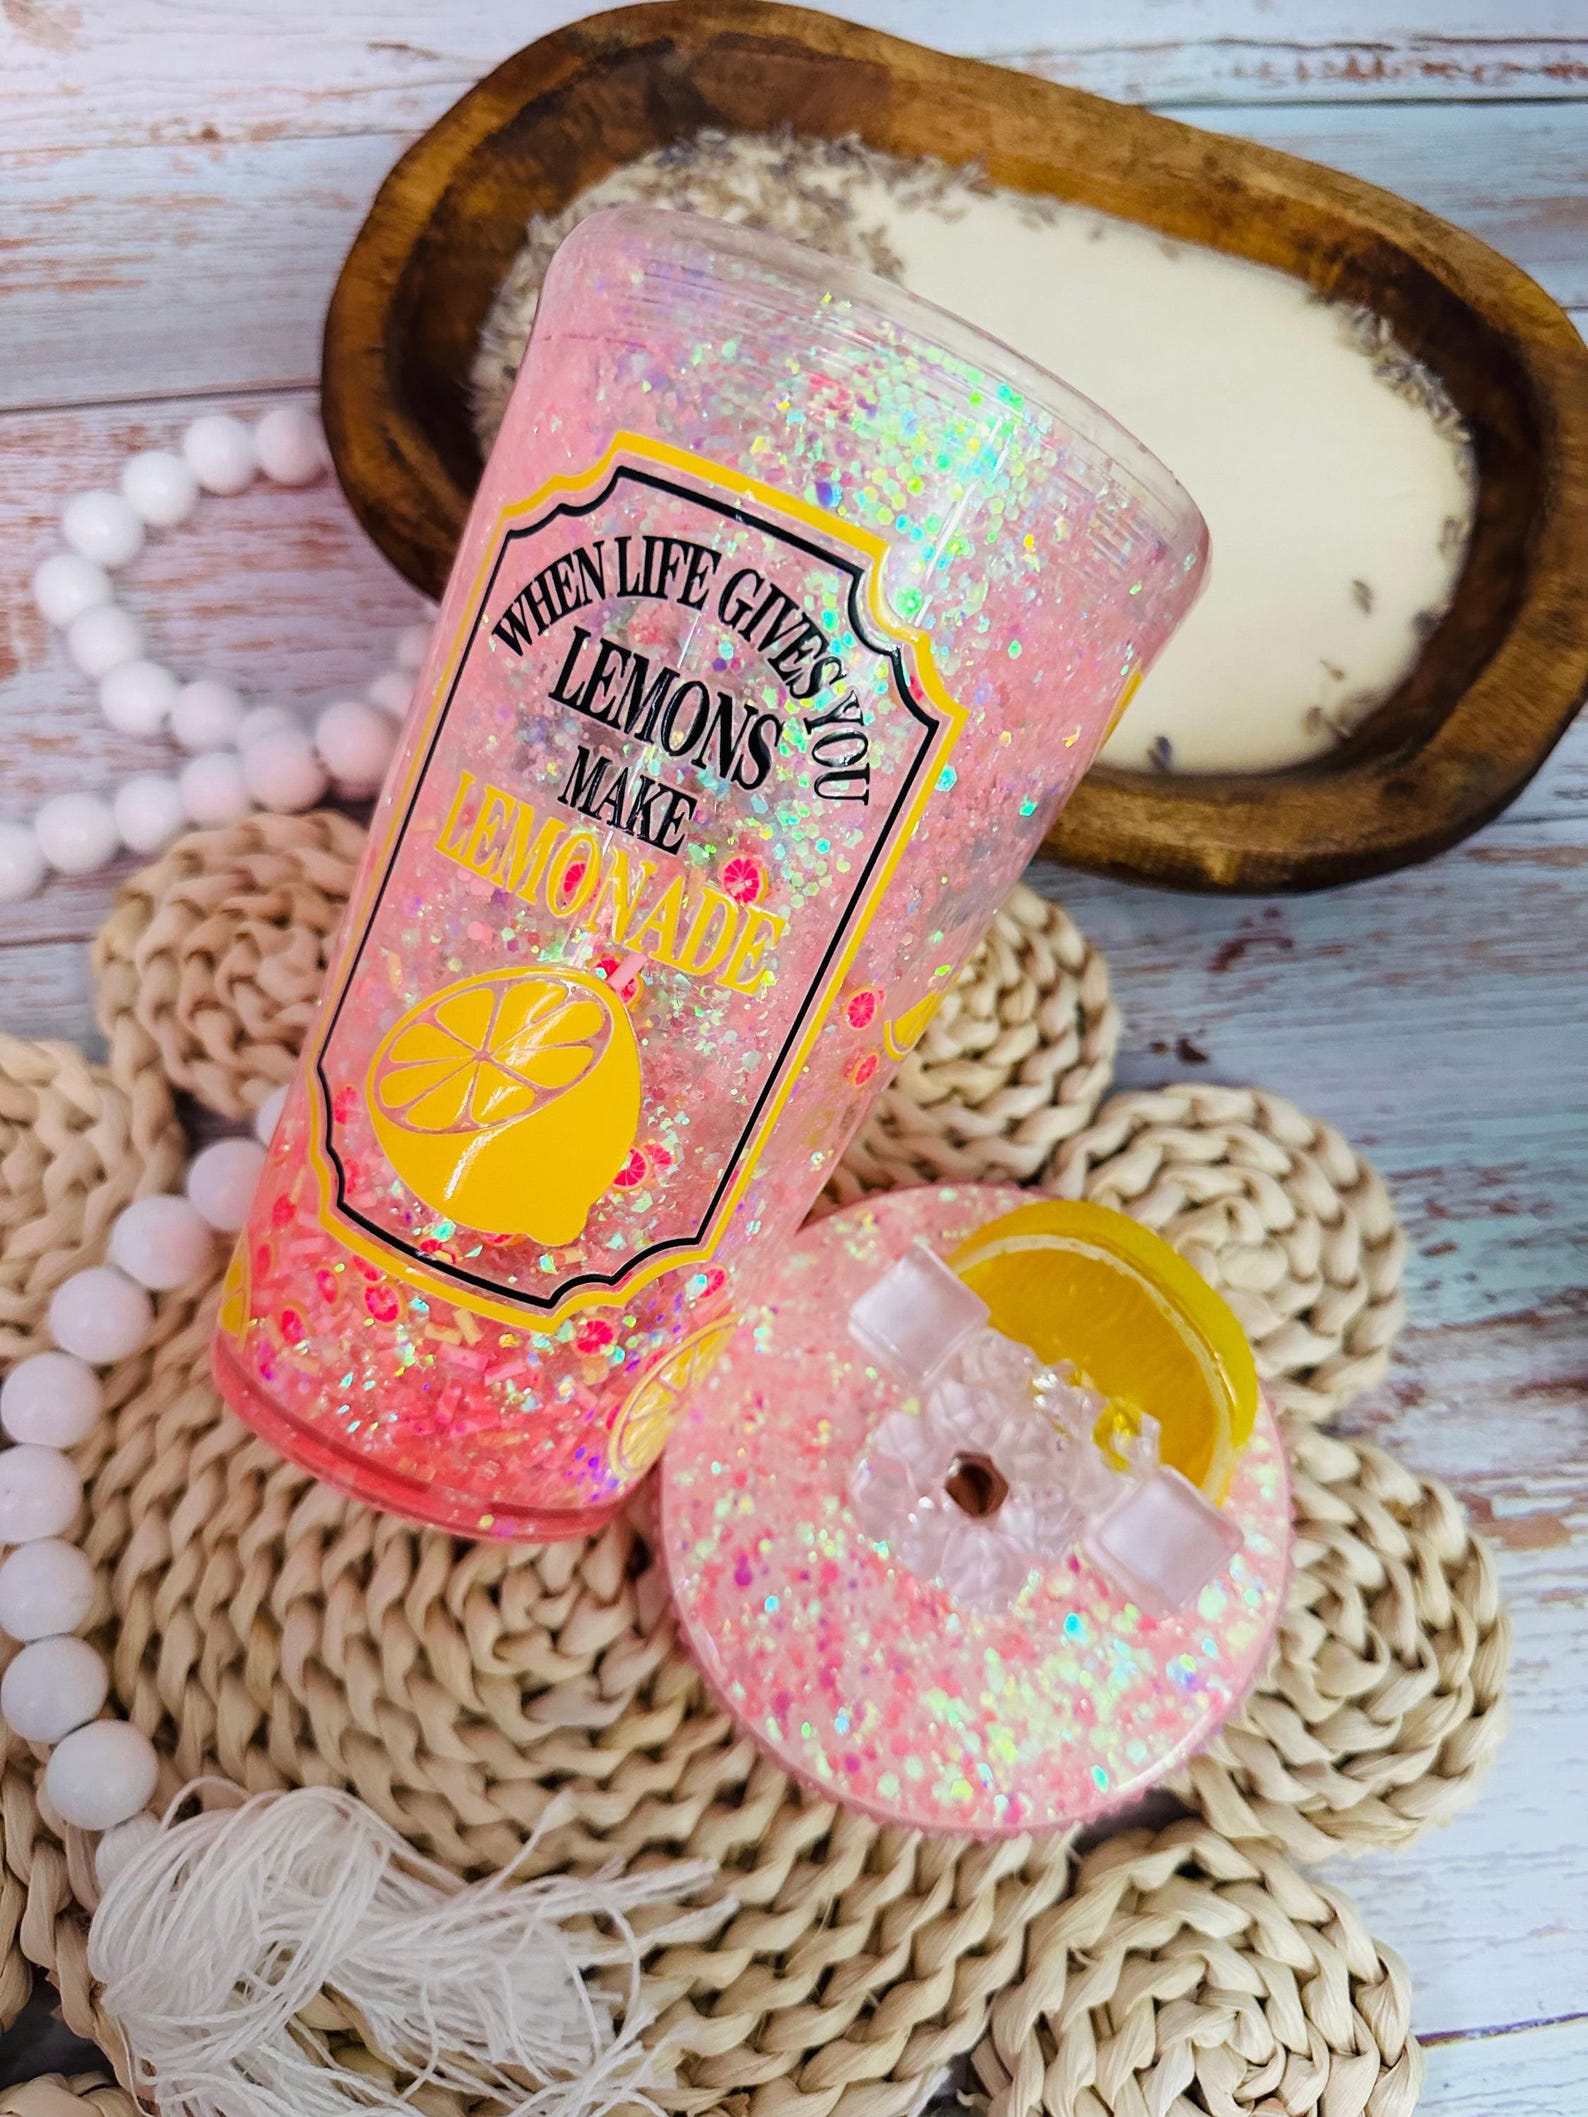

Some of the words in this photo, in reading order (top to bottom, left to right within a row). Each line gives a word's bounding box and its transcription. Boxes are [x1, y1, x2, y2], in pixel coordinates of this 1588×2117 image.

[491, 540, 607, 657] WHEN
[614, 535, 722, 610] LIFE
[717, 567, 846, 701] GIVES
[804, 690, 870, 806] YOU
[548, 626, 784, 790] LEMONS
[434, 770, 785, 996] LEMONADE
[558, 745, 697, 855] MAKE
